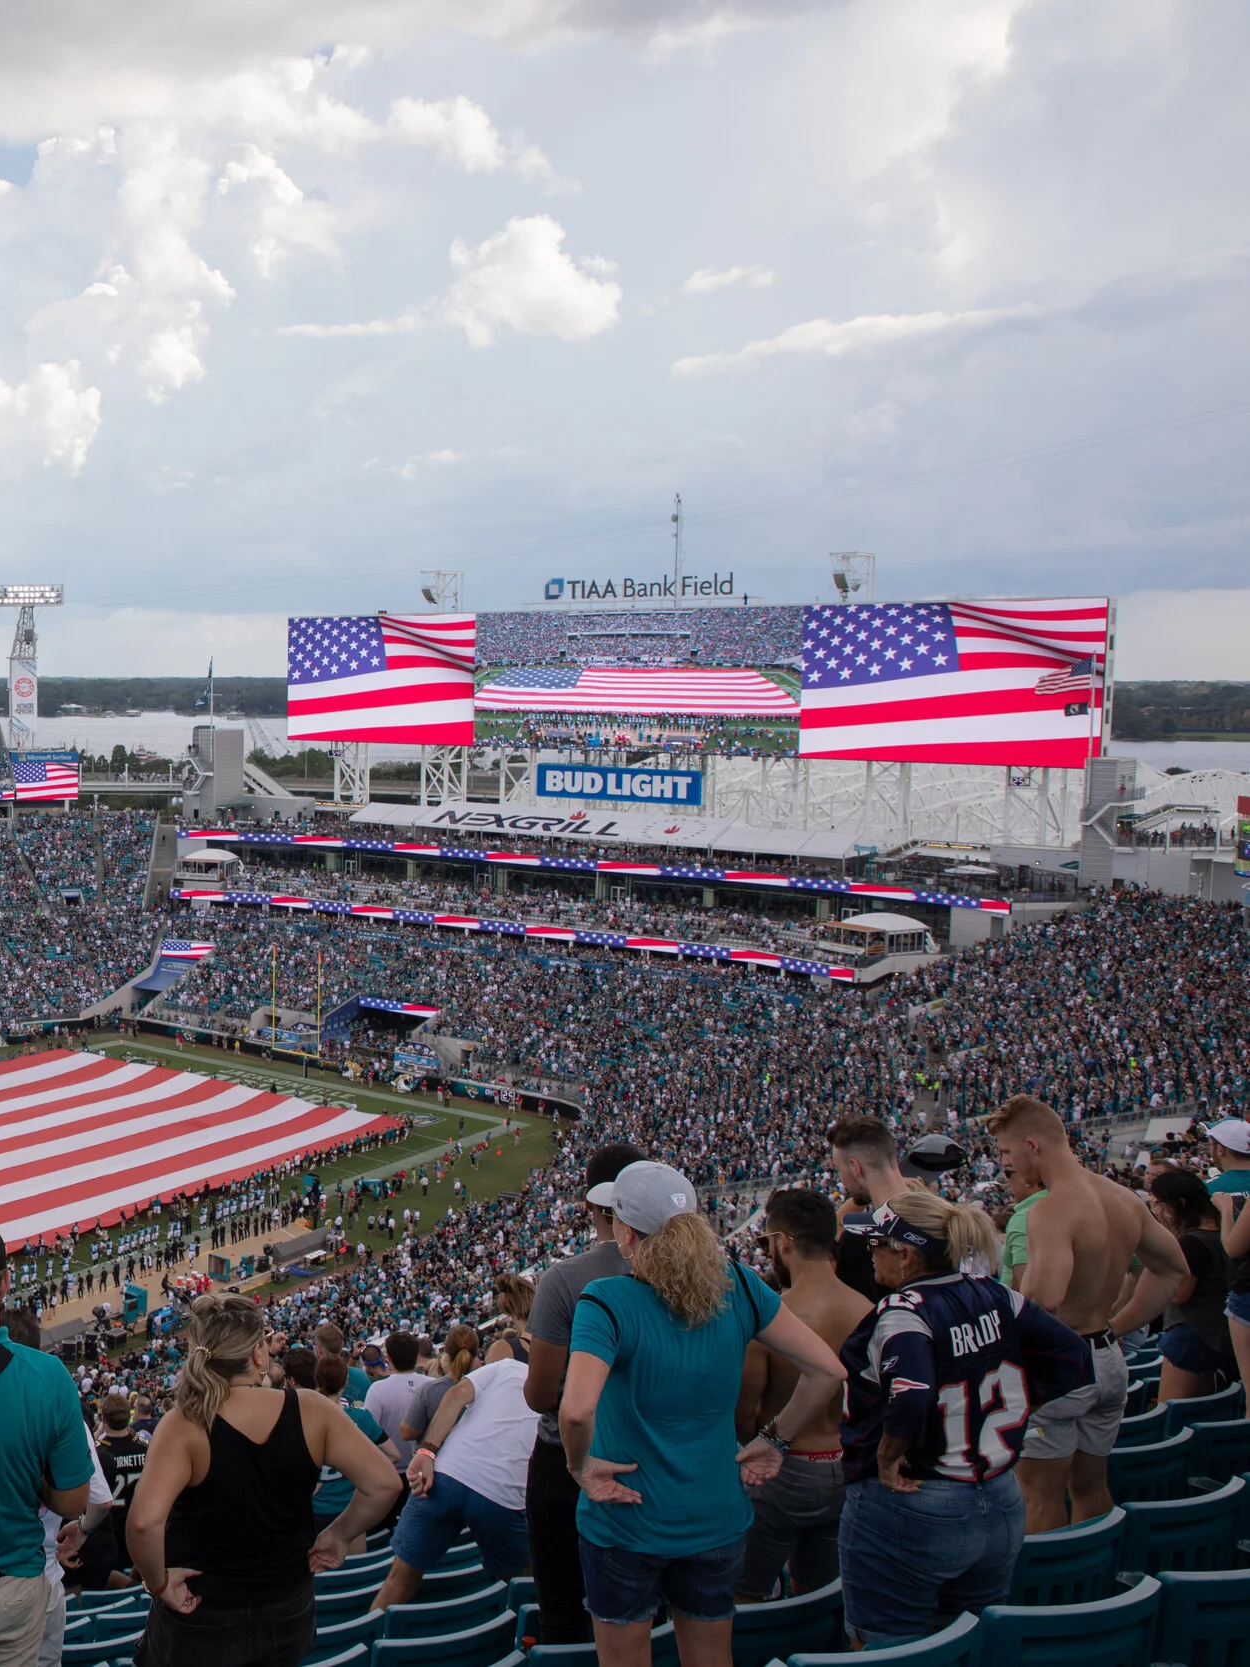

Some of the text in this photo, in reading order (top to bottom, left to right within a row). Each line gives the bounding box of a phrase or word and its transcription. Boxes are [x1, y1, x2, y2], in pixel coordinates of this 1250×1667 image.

[566, 572, 734, 599] TIAA Bank Field
[545, 770, 692, 800] BUD LIGHT
[431, 809, 621, 837] NEXGRILL
[934, 1359, 1031, 1483] 12
